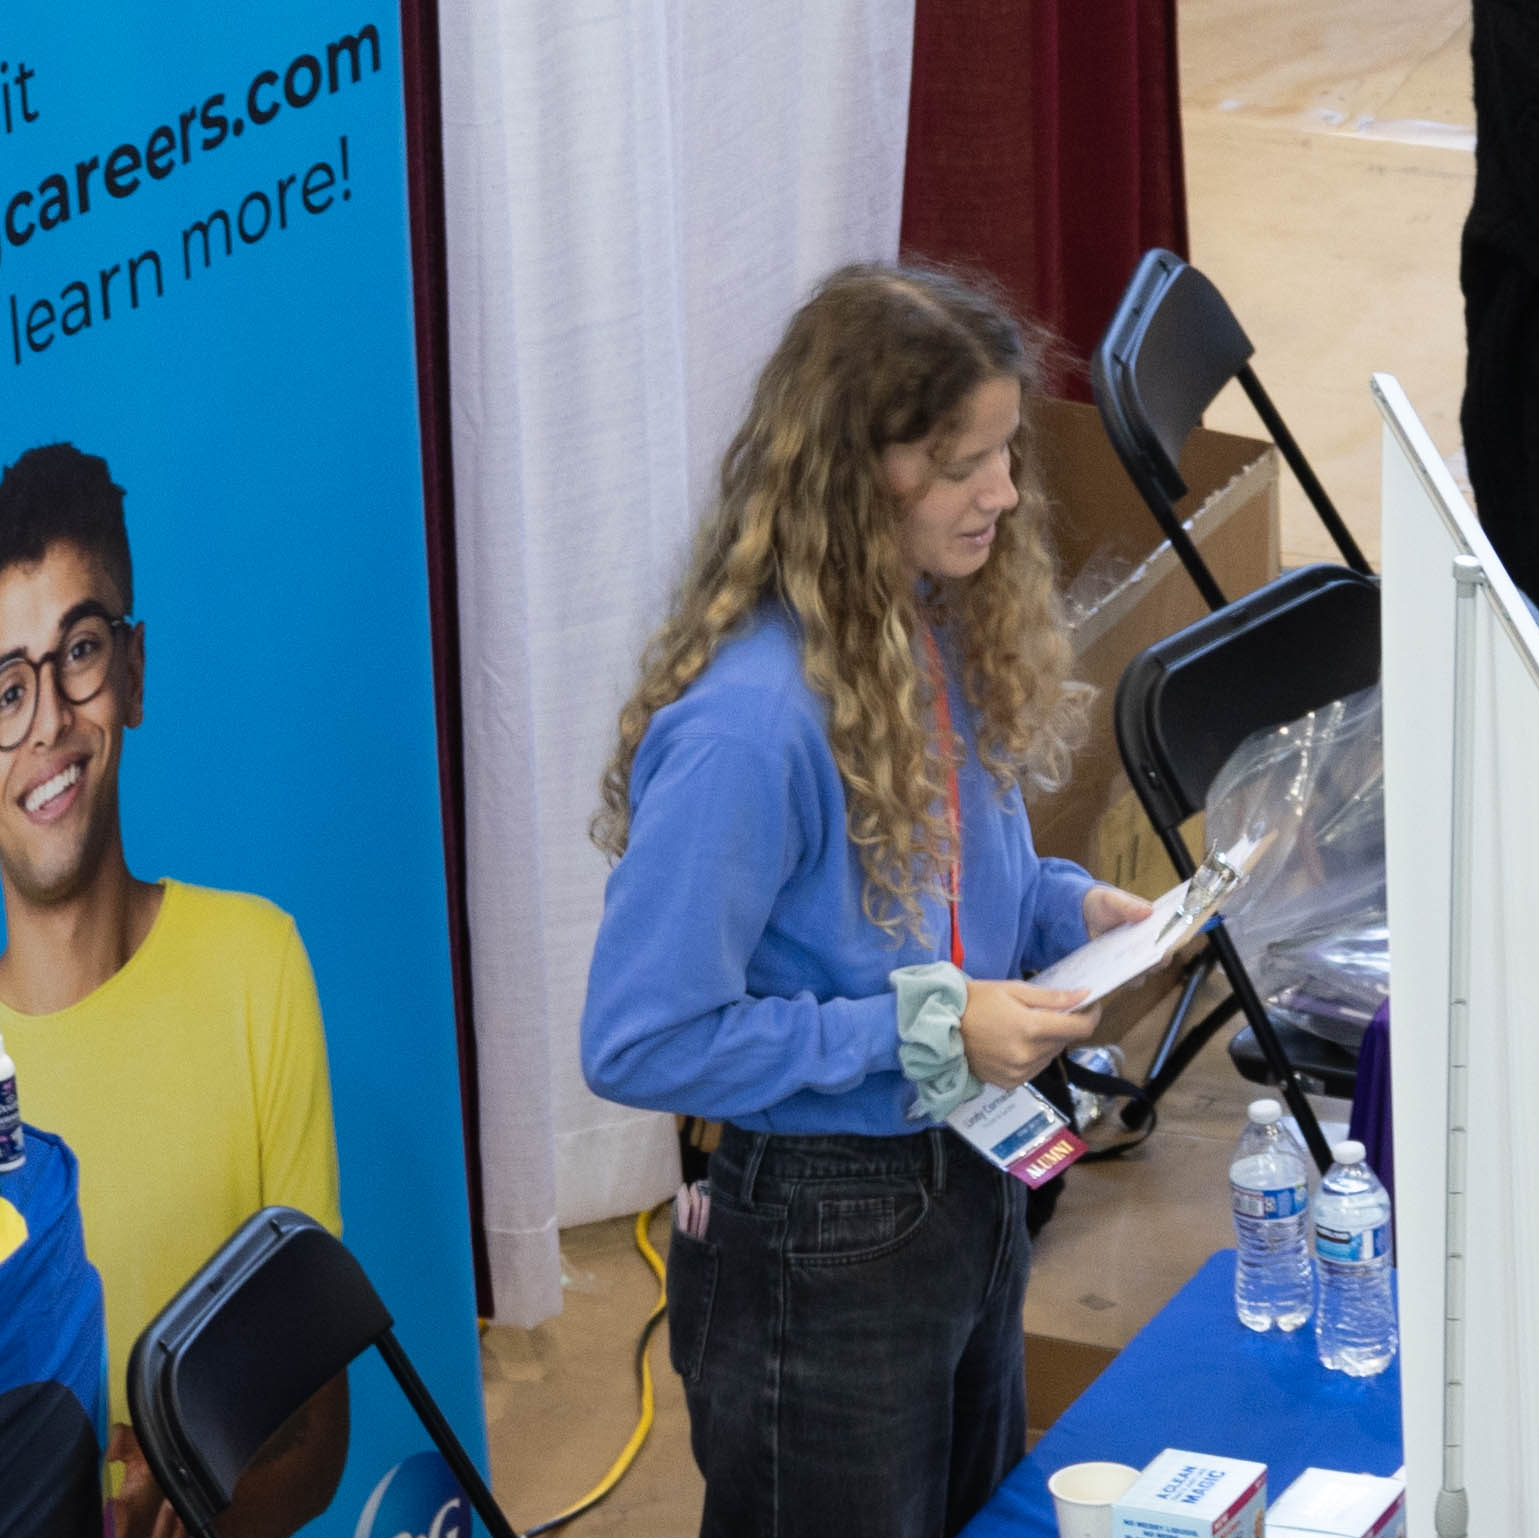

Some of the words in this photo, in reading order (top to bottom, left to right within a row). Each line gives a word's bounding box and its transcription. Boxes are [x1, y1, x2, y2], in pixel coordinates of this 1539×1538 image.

[0, 23, 381, 266] careers.com
[9, 249, 164, 366] learn
[181, 136, 354, 281] more!
[1026, 1140, 1075, 1179] ALUMNI
[1181, 1469, 1226, 1504] MAGIC
